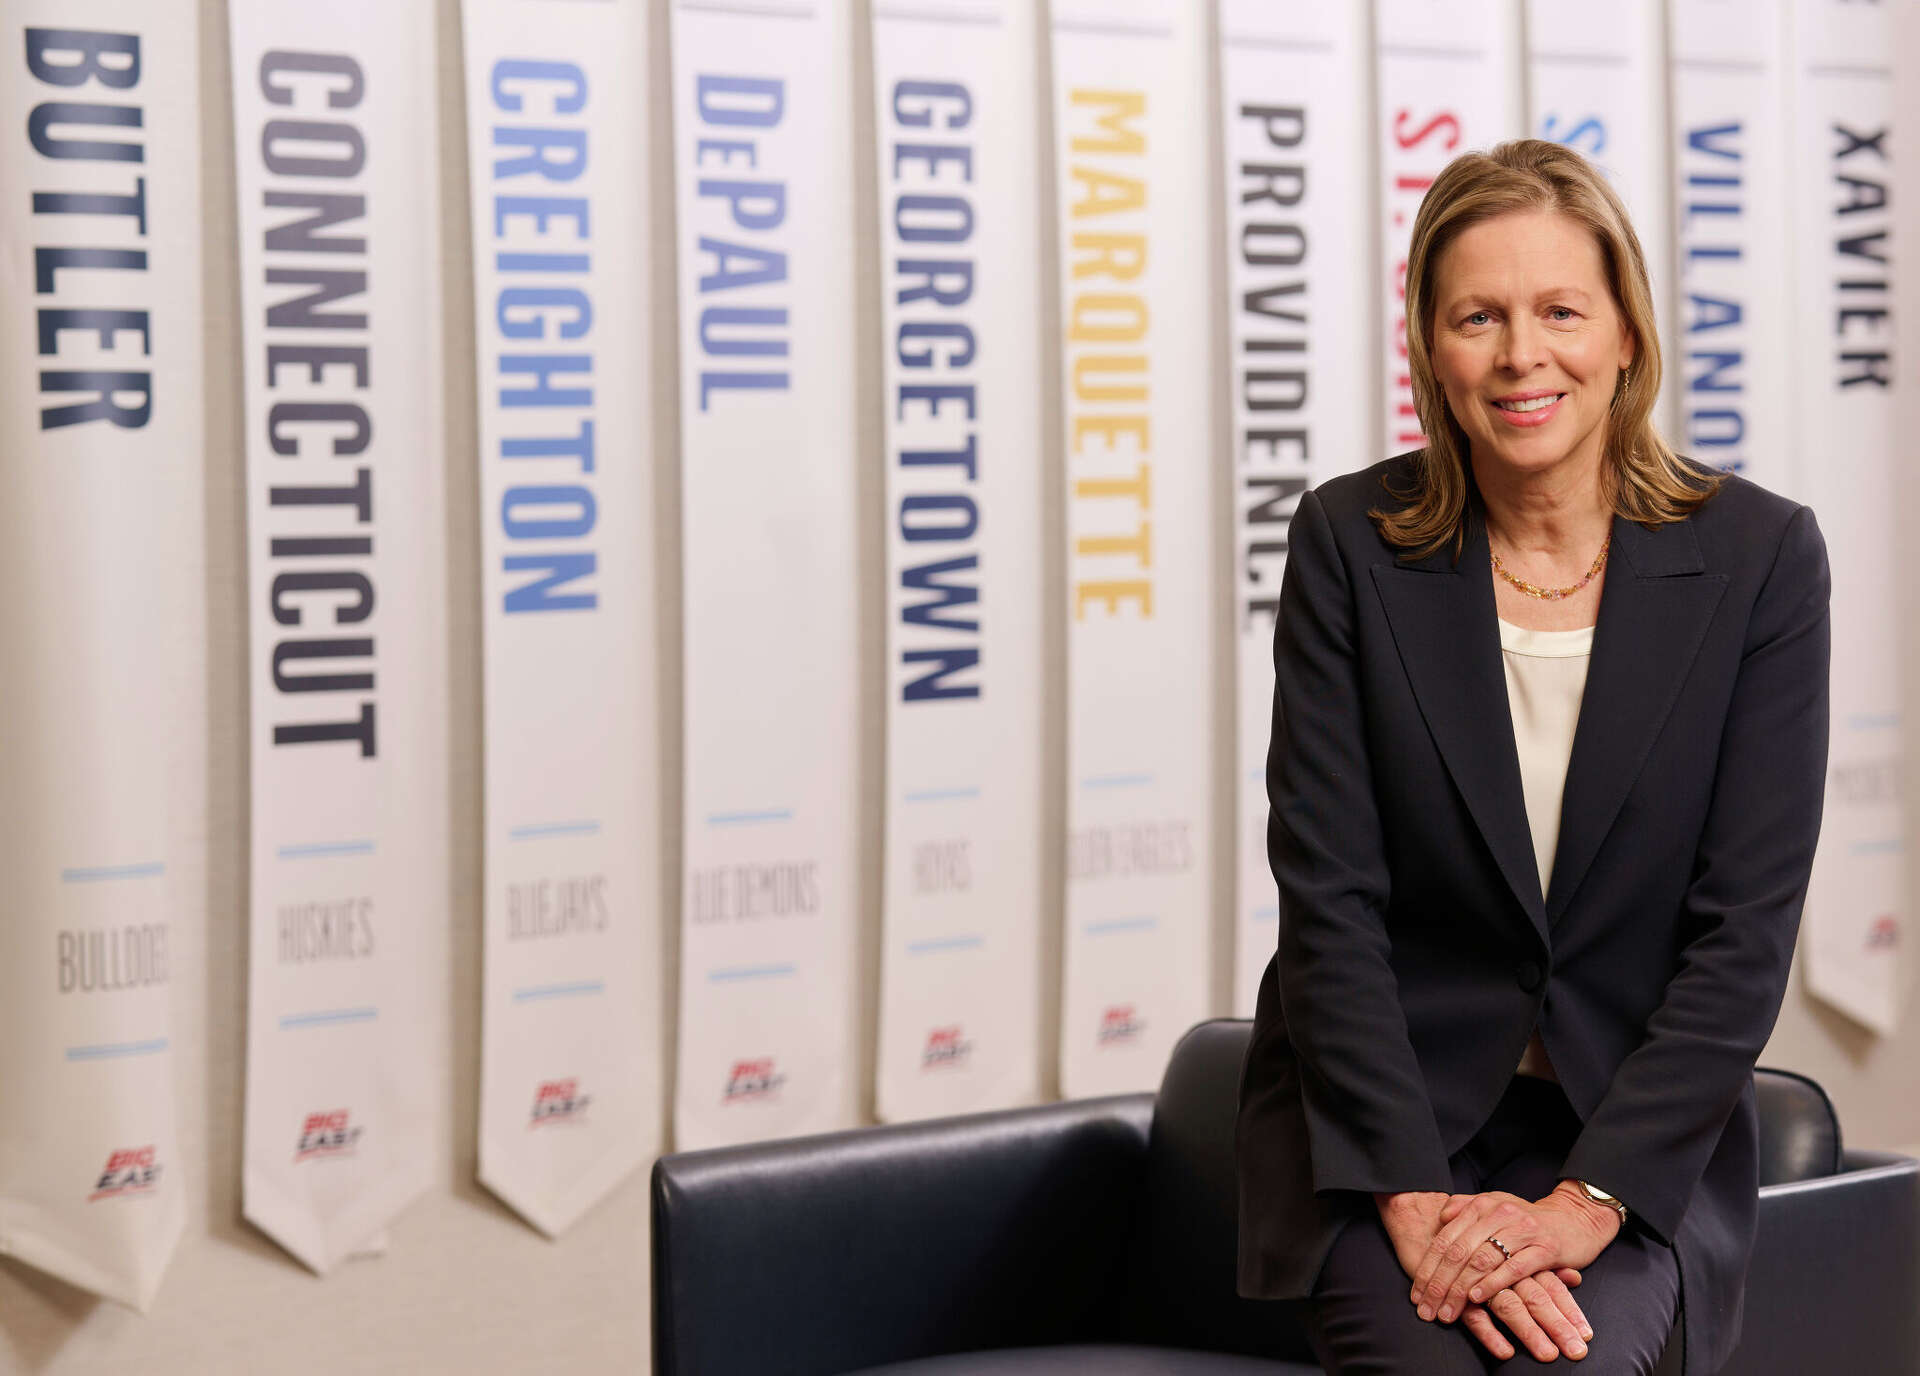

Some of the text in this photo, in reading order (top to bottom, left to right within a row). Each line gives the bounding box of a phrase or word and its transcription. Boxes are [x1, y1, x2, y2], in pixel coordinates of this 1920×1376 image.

[24, 27, 153, 433] BUTLER
[260, 49, 378, 760] CONNECTICUT
[491, 58, 599, 615] CREIGHTON
[893, 80, 982, 704] GEORGETOWN
[1068, 88, 1154, 623] MARQUETTE
[1833, 123, 1893, 391] XAVIER
